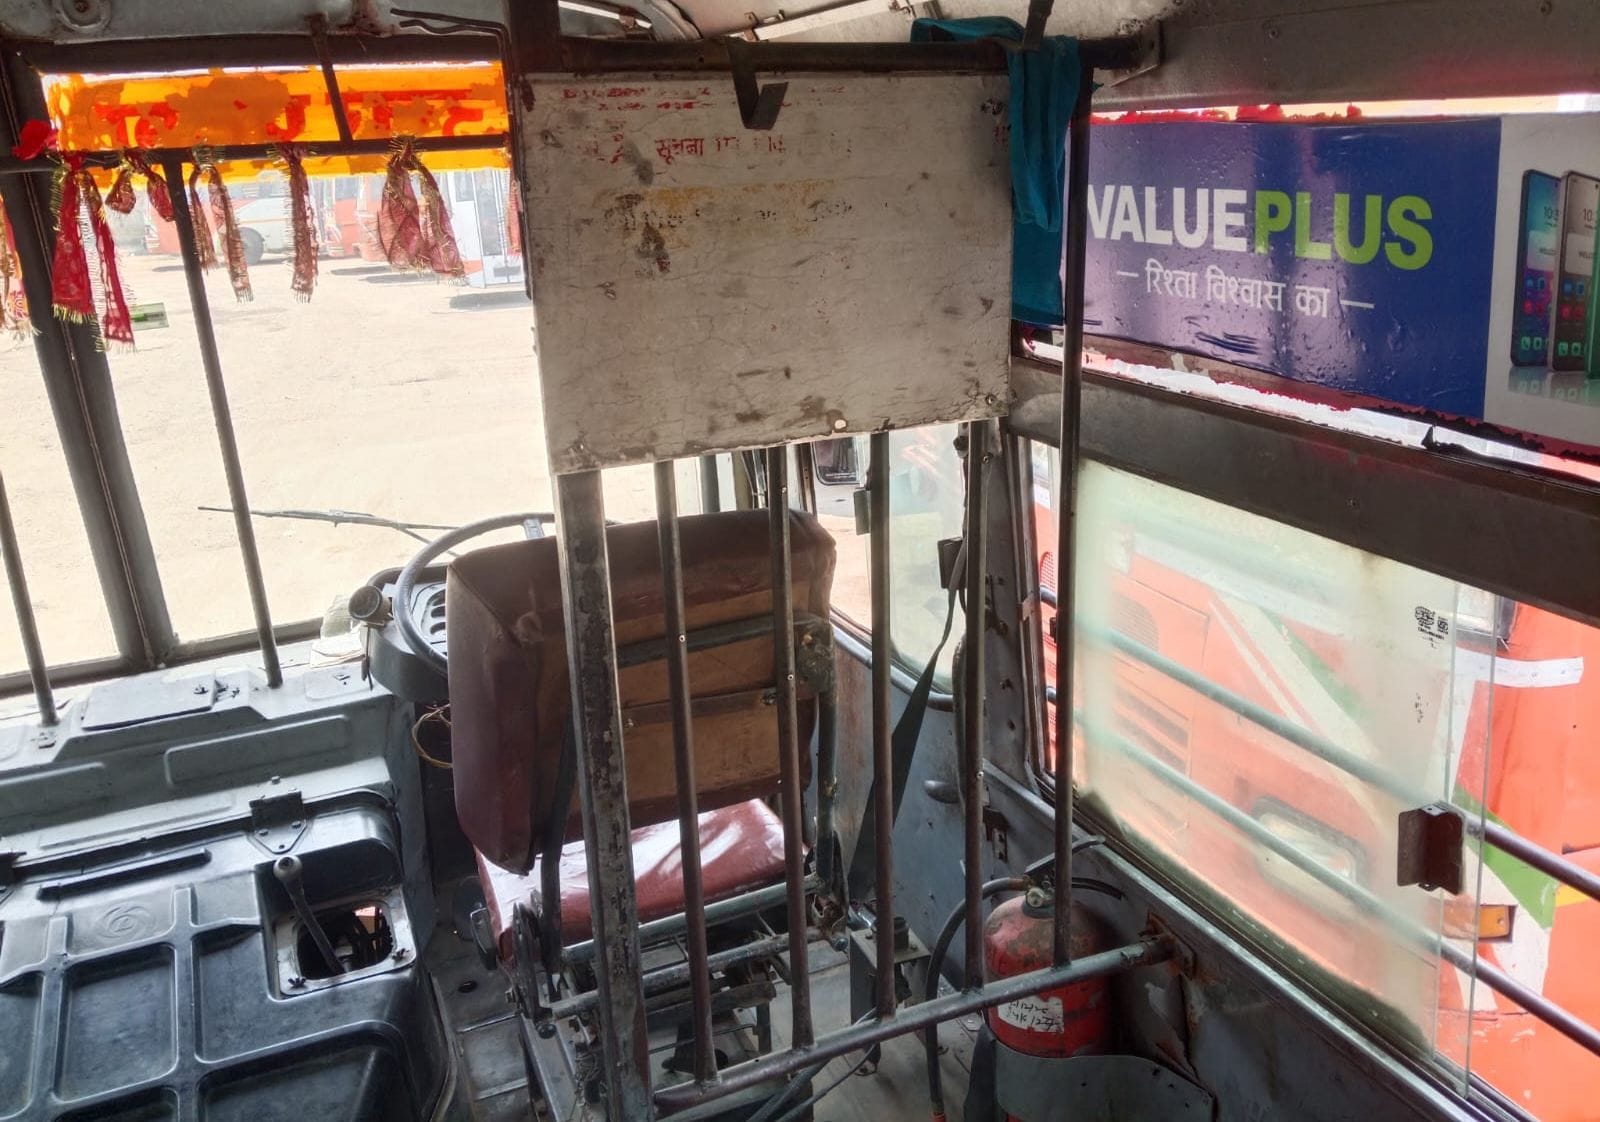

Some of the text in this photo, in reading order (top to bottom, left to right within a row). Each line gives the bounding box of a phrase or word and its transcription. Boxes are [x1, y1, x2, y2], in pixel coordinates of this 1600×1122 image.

[1145, 257, 1330, 318] रिश्ता विश्वास का
